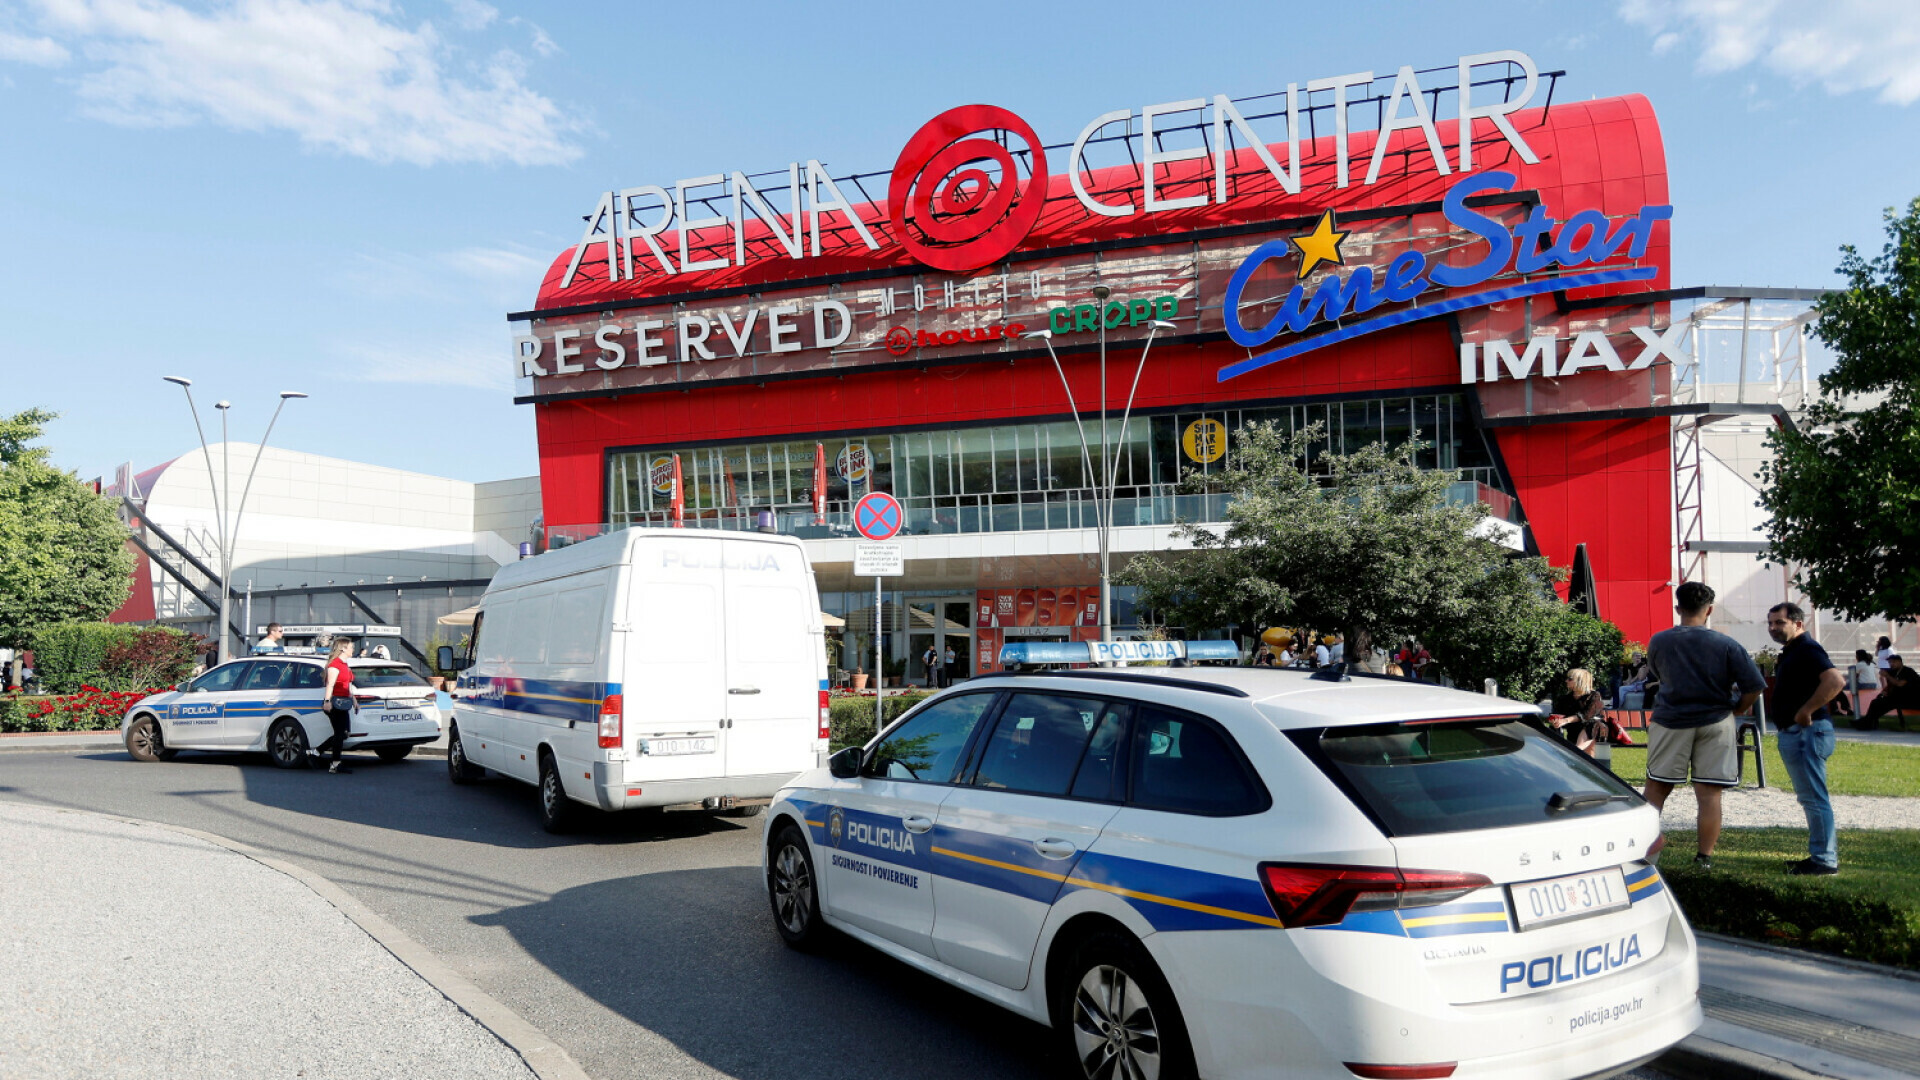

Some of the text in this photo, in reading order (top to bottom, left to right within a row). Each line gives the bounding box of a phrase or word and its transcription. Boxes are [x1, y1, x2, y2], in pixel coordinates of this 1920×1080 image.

[559, 50, 1541, 289] ARENA CENTAR
[1221, 171, 1674, 349] CineStar
[881, 270, 1041, 315] MOHITO
[1050, 295, 1179, 334] CROPP
[514, 299, 852, 379] RESERVED
[916, 321, 1028, 347] house
[1460, 323, 1695, 384] IMAX
[1019, 627, 1050, 636] ULAZ
[1100, 642, 1177, 661] POLICIJA
[182, 706, 218, 716] POLICIJA
[381, 713, 423, 722] POLICIJA
[848, 821, 916, 855] POLICIJA
[1519, 838, 1636, 866] ŠKODA
[832, 854, 868, 876] SIGURNOST
[873, 866, 919, 889] POVJERENJE
[1529, 875, 1613, 917] 010 311
[1500, 933, 1642, 993] POLICIJA
[1569, 997, 1643, 1032] policija.gov.hr
